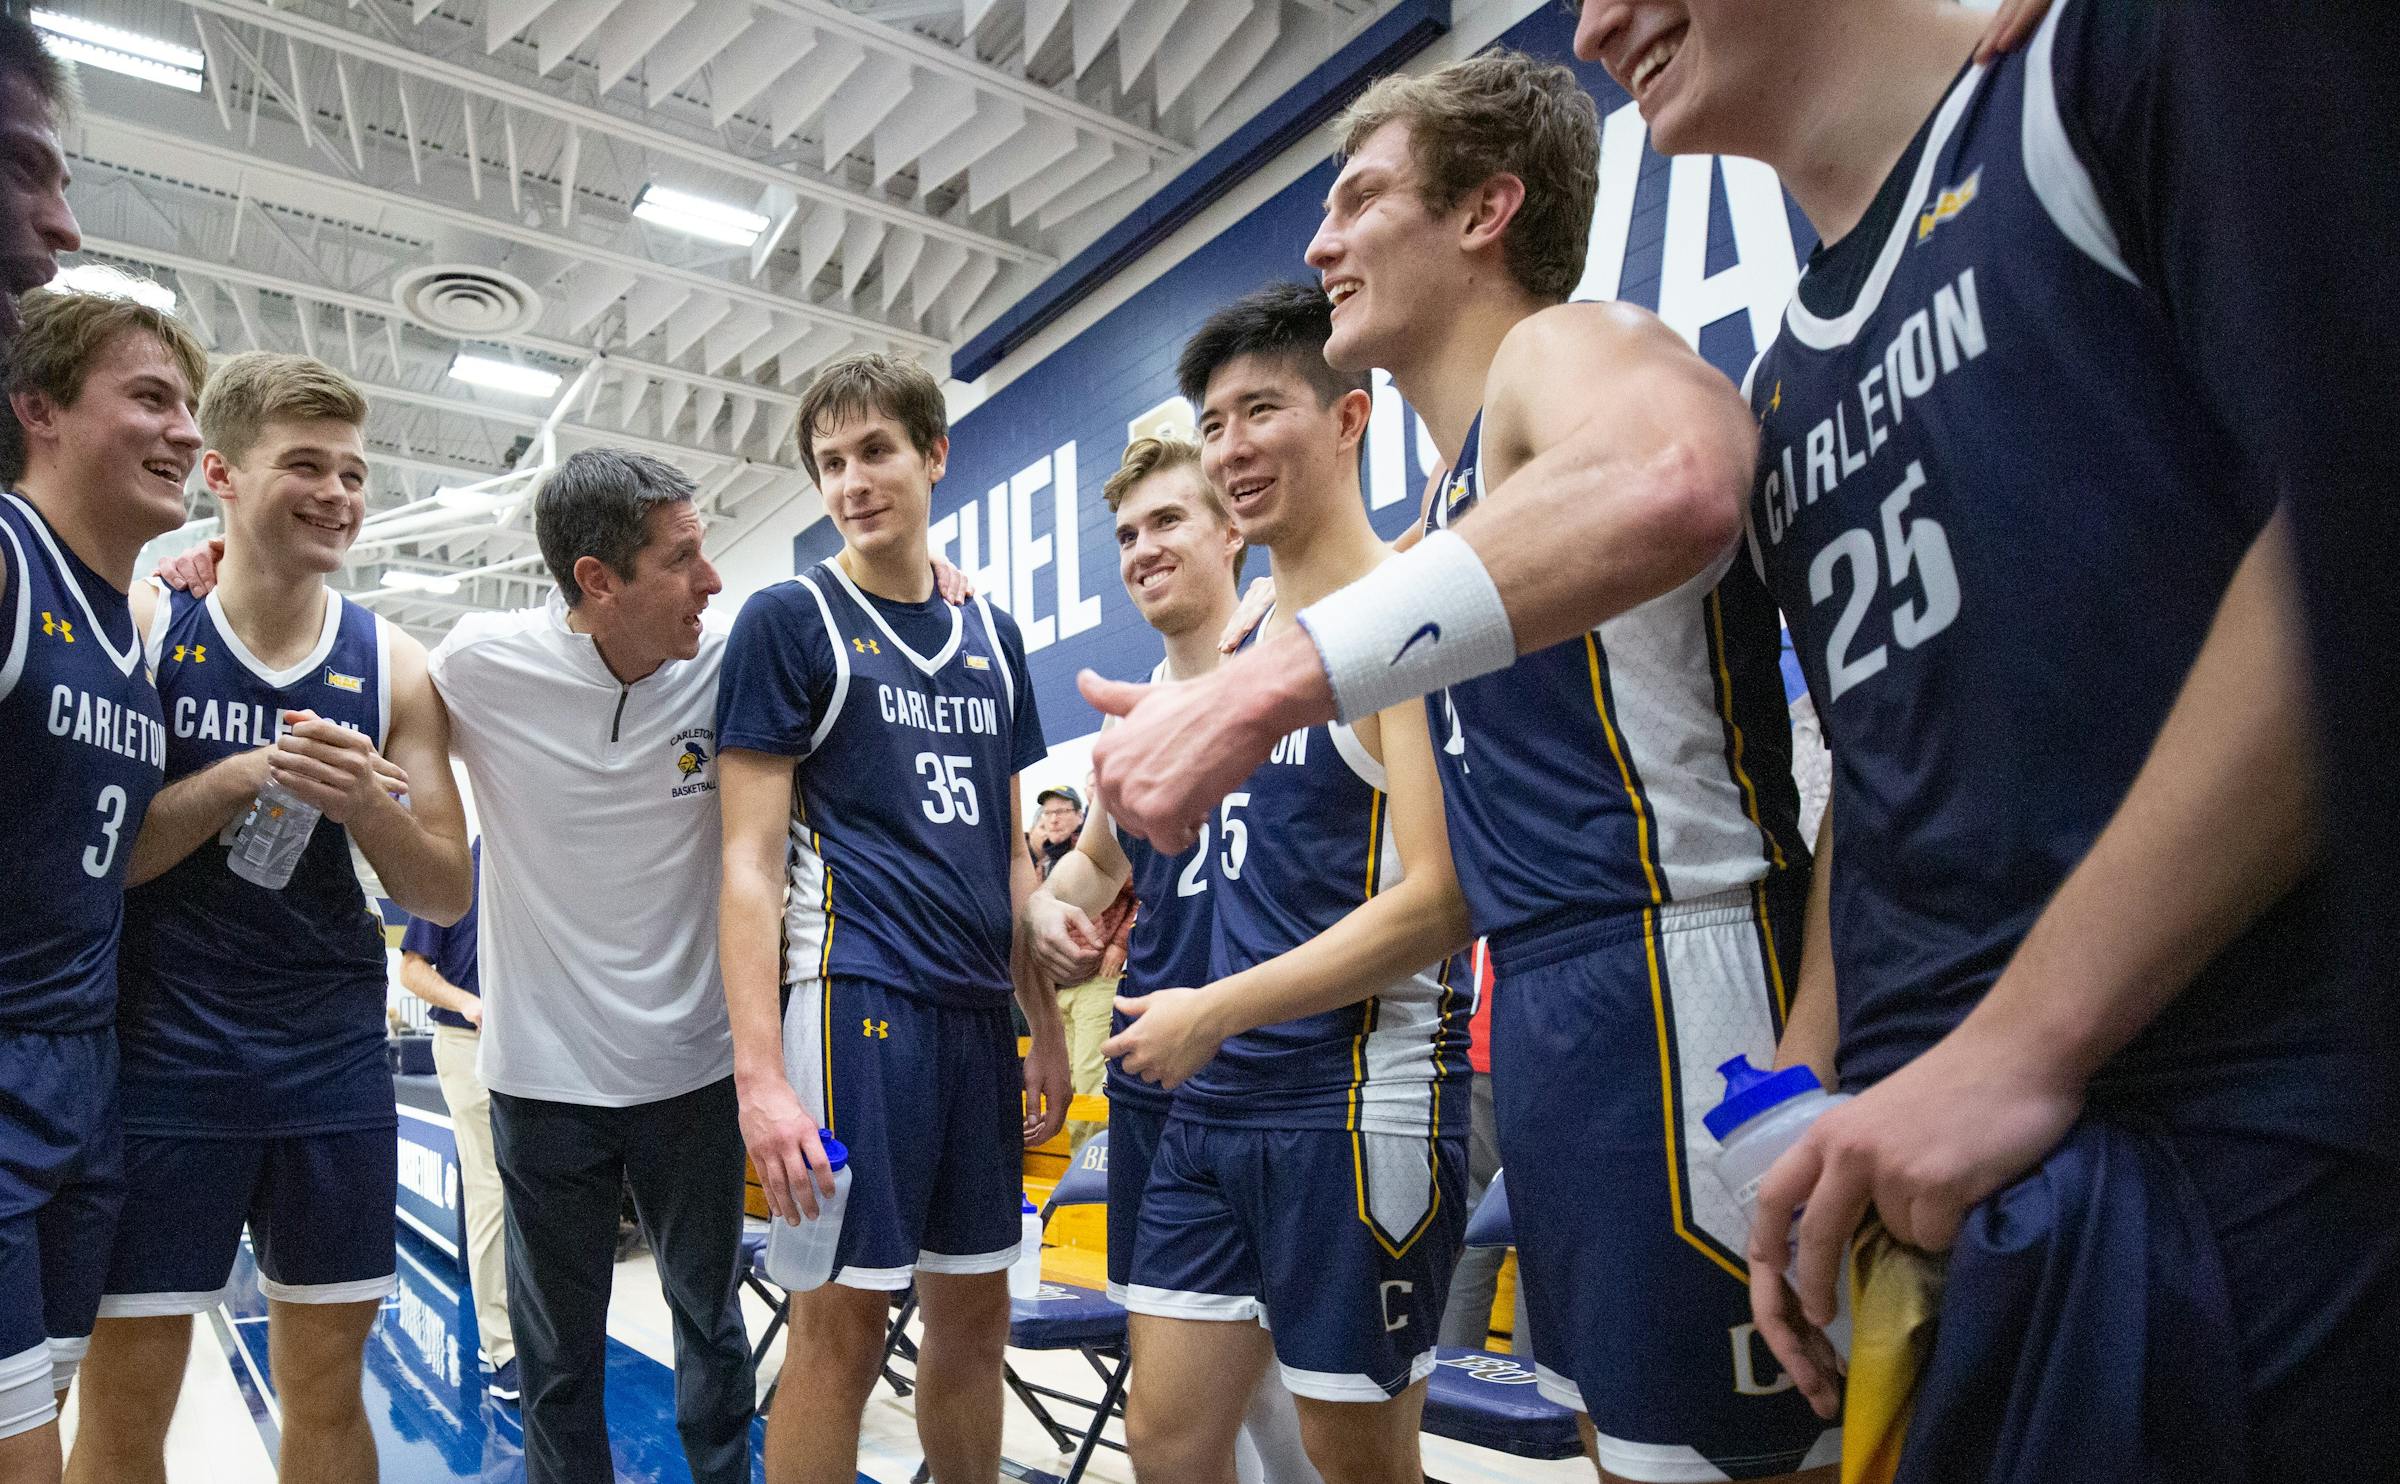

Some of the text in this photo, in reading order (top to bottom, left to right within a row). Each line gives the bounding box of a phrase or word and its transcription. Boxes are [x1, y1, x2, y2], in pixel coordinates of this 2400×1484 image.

[1764, 266, 1988, 546] CARLETON
[1808, 460, 1962, 703] 25
[48, 684, 167, 771] CARLETON
[174, 696, 359, 747] CARLE
[670, 728, 714, 746] CARLETON
[878, 684, 998, 736] CARLETON
[672, 781, 716, 798] BASKETBALL
[915, 752, 980, 826] 35
[82, 785, 127, 878] 3
[1380, 1280, 1413, 1332] C
